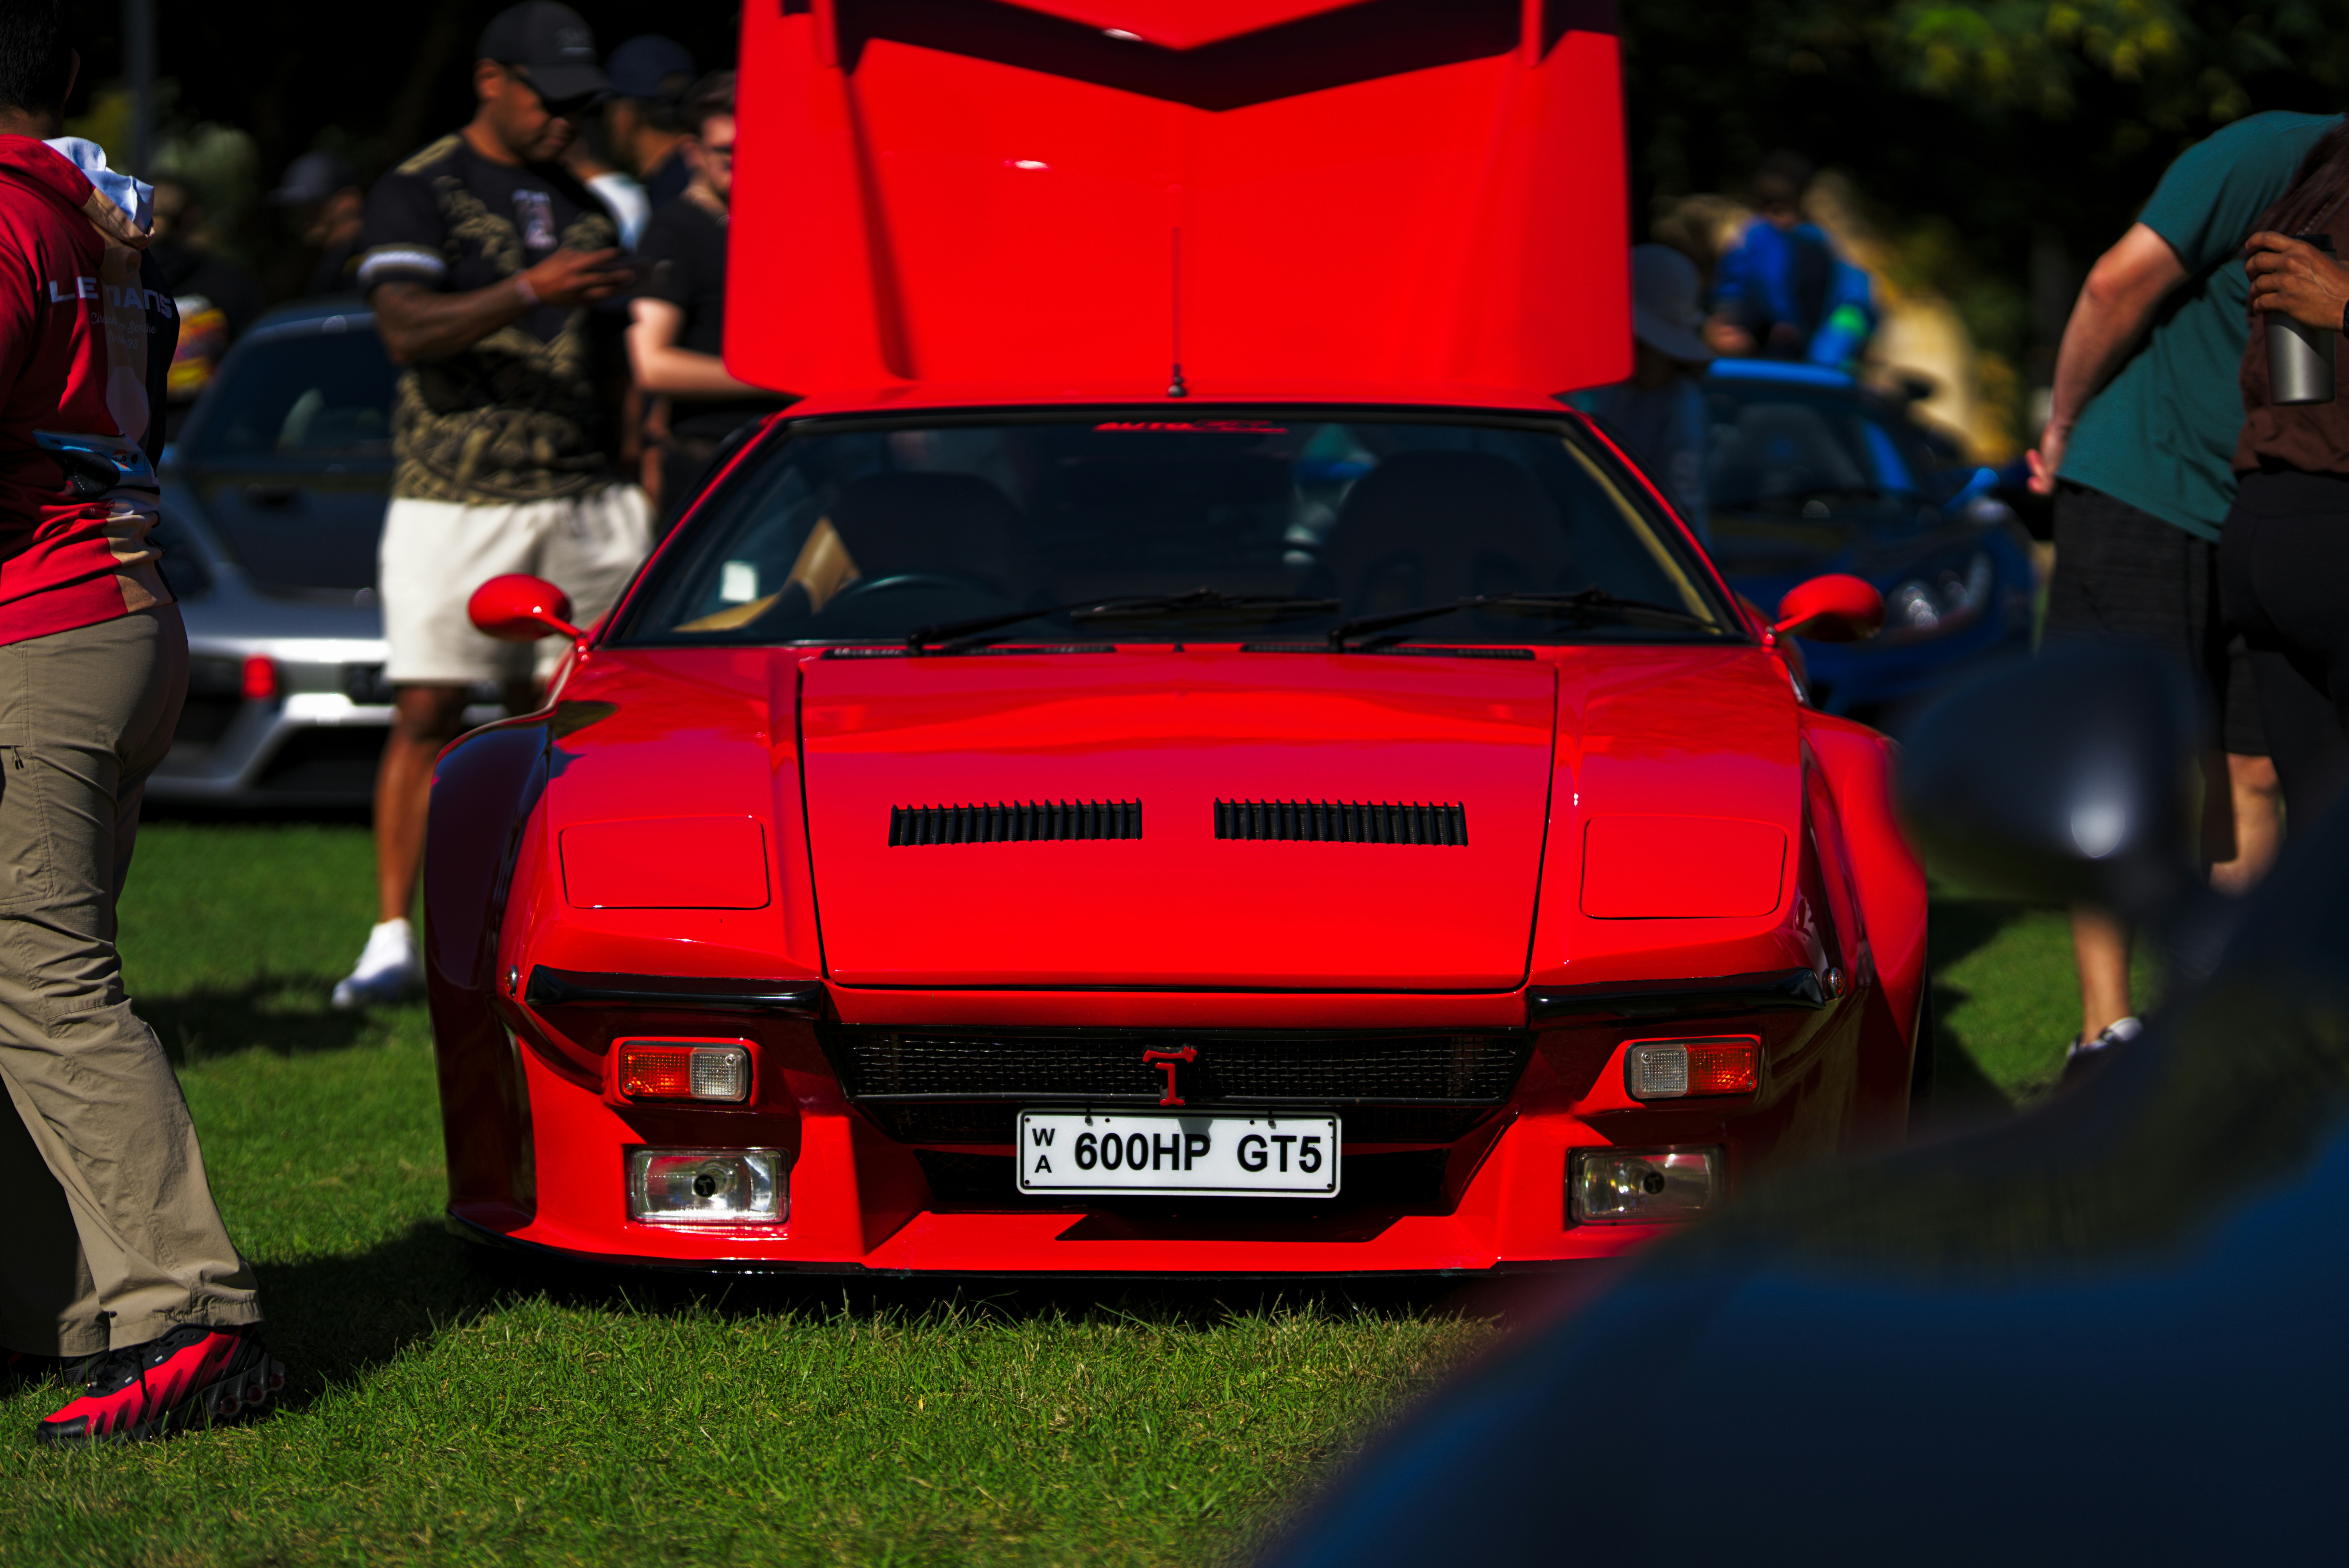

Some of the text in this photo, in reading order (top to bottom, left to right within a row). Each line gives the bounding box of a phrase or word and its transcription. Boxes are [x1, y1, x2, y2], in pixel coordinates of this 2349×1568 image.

[50, 276, 99, 303] LE
[127, 320, 157, 334] Sarthe
[1074, 1133, 1322, 1173] 600HP GT5
